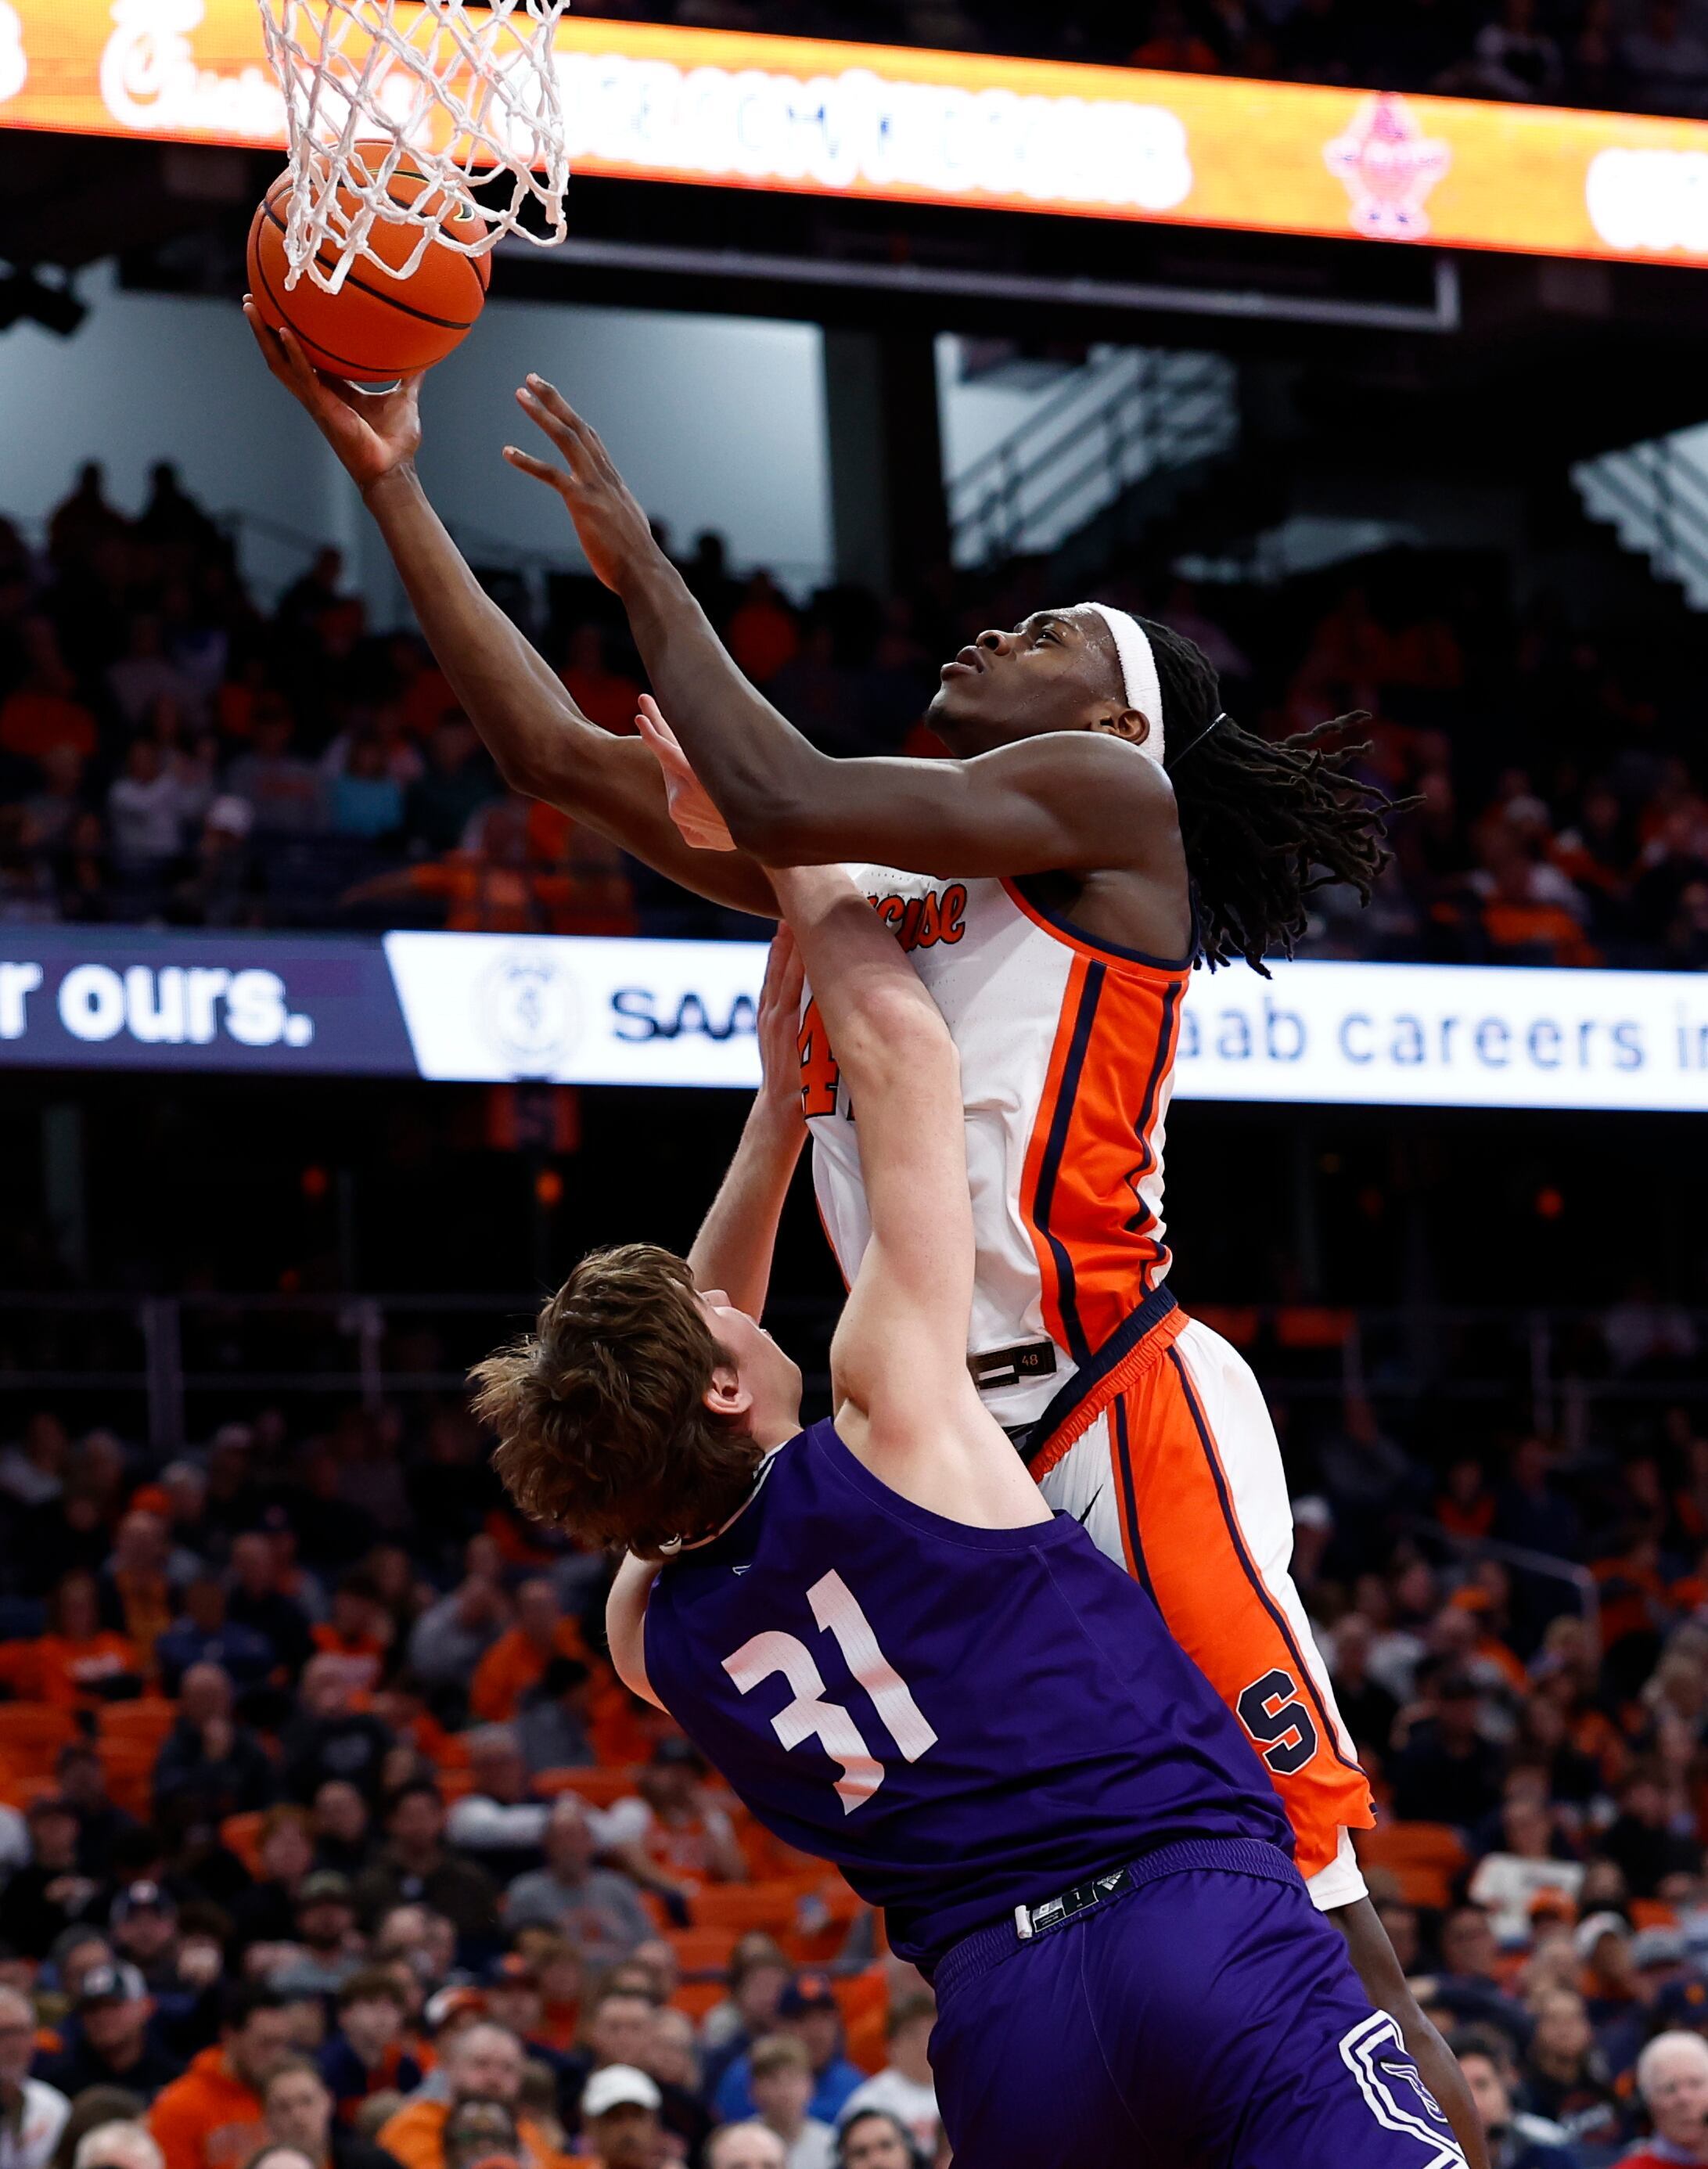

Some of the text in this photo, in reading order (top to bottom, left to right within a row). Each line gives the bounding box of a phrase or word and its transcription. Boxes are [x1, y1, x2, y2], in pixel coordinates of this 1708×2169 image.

[868, 883, 968, 953] cuse
[58, 963, 315, 1047] ours.
[1339, 1012, 1645, 1071] careers
[1021, 1354, 1039, 1367] 48
[721, 1568, 939, 1816] 31
[1236, 1667, 1318, 1775] S
